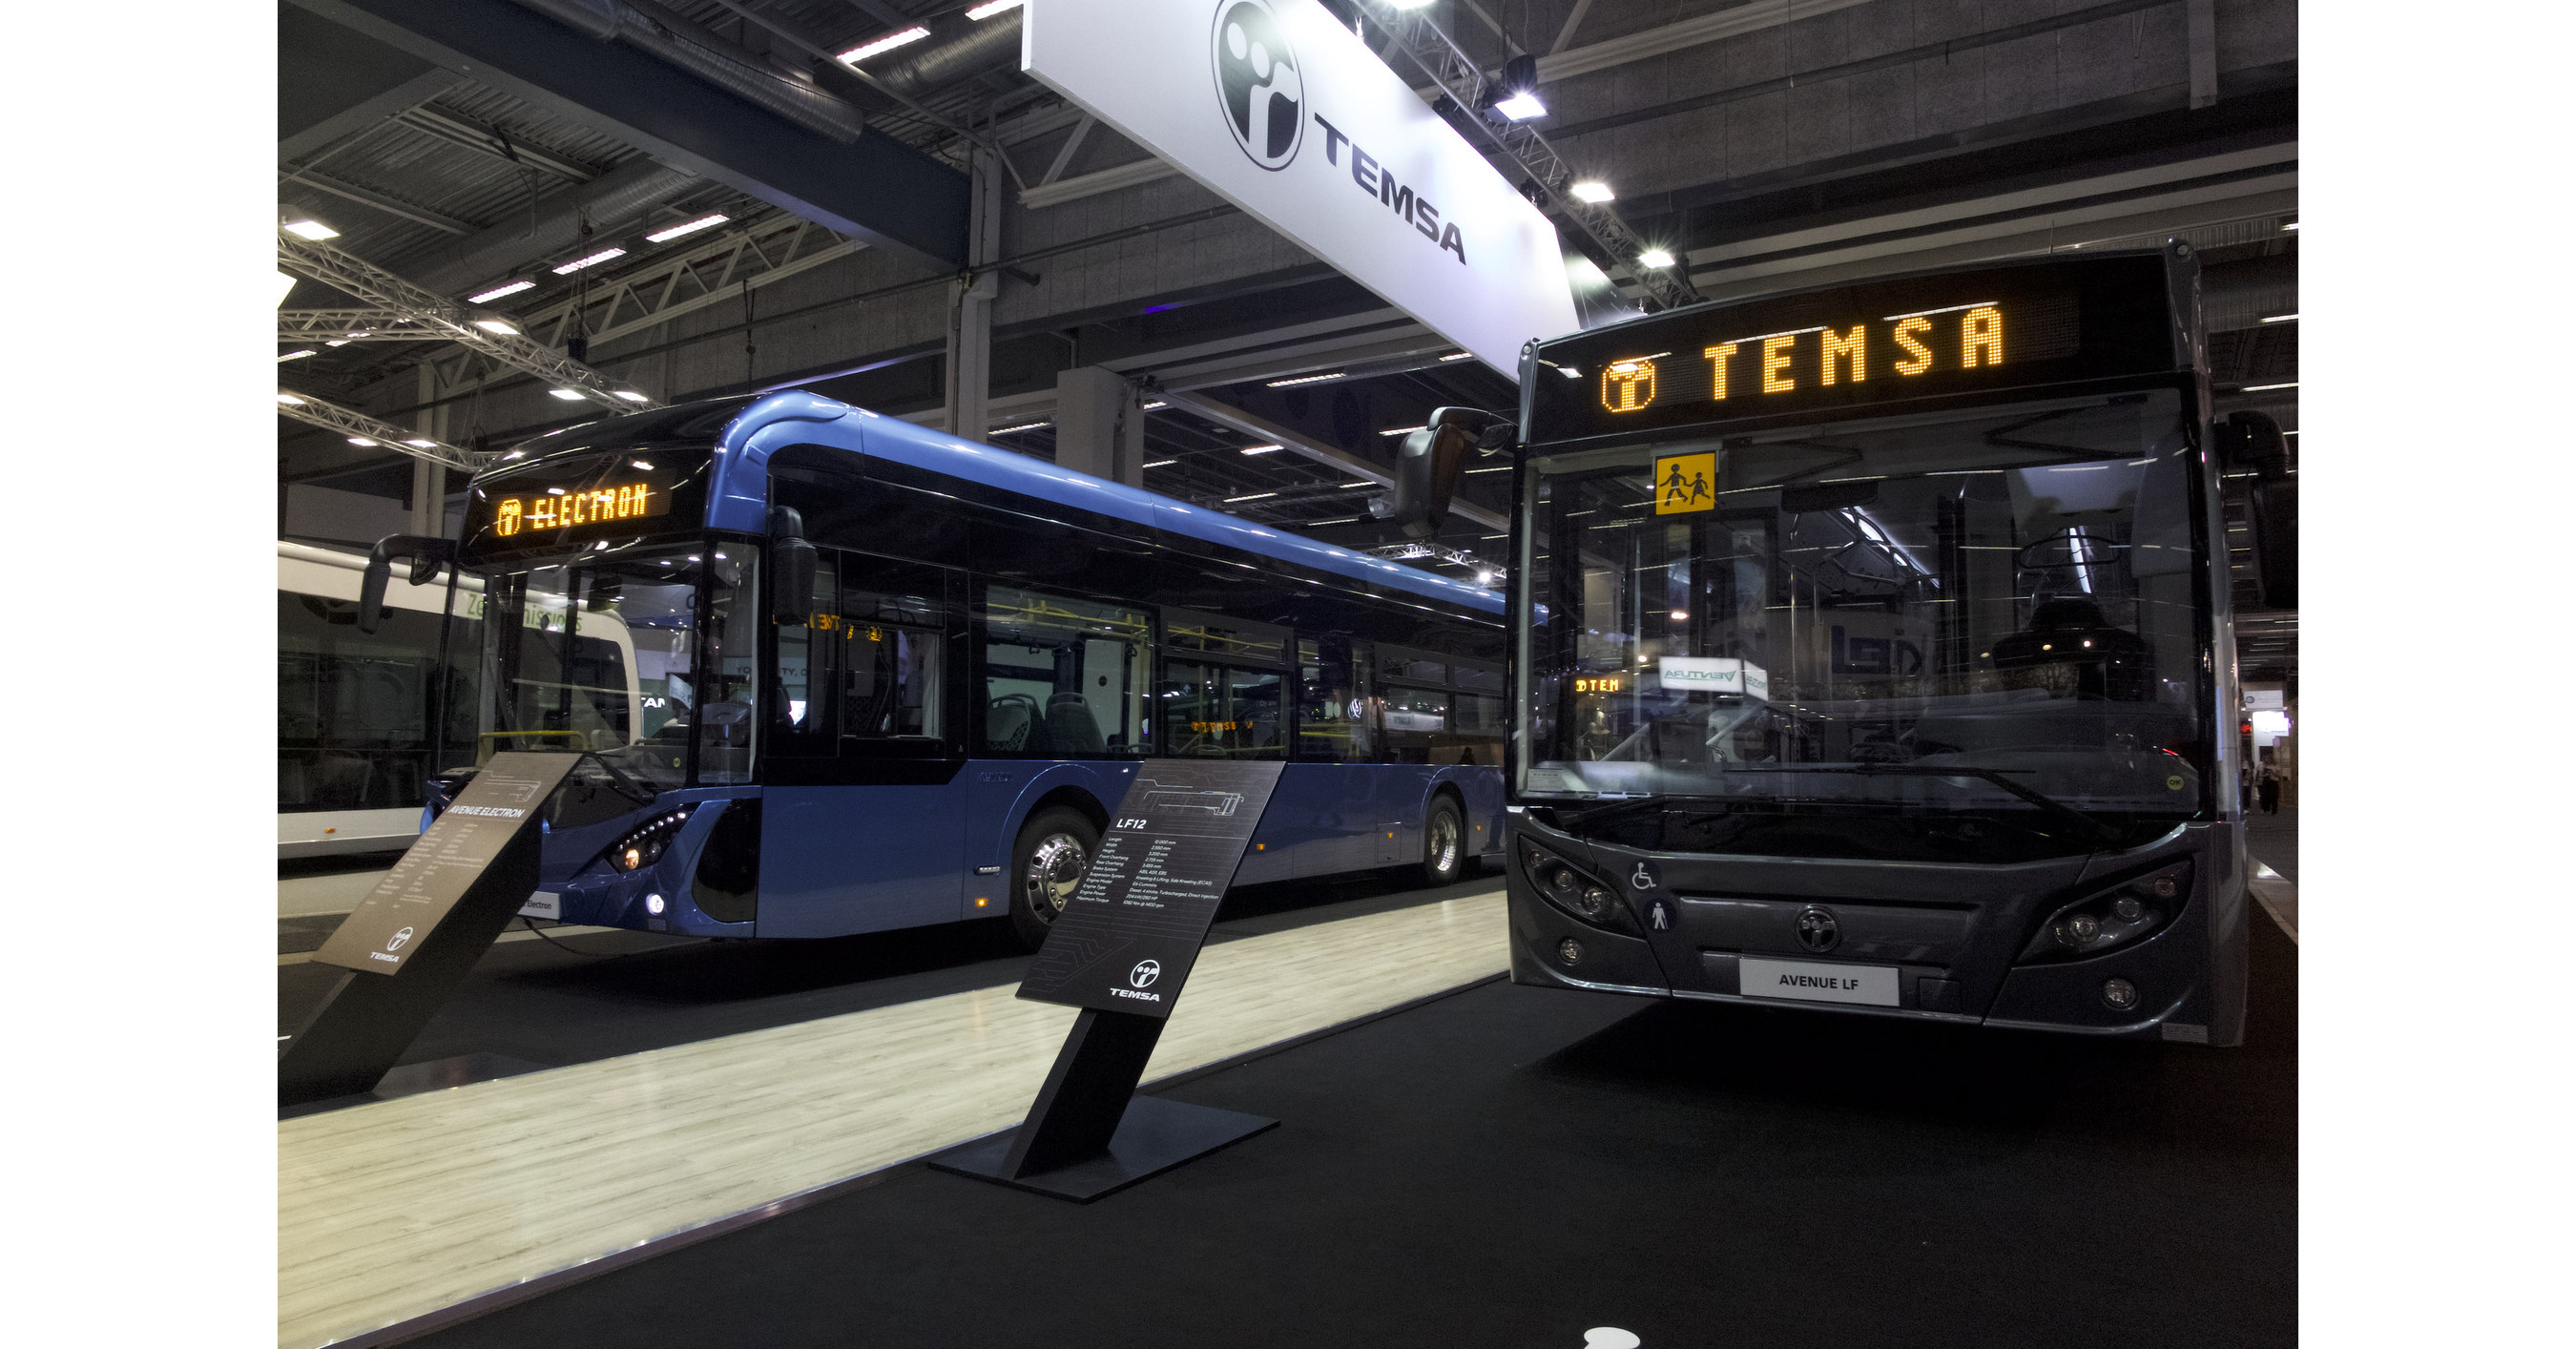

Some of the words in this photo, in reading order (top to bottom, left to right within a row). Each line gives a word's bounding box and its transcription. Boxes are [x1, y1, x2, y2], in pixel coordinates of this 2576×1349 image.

[1314, 113, 1466, 266] TEMSA
[1704, 306, 2004, 401] TEMSA
[531, 483, 649, 530] ELECTRON
[448, 805, 484, 816] AVENUE
[479, 807, 526, 818] ELECTRON
[1116, 819, 1147, 829] LF12
[527, 900, 551, 909] Electron
[370, 951, 400, 963] TEMSA
[1779, 974, 1838, 989] AVENUE
[1841, 978, 1859, 991] LF
[1110, 987, 1160, 1002] TEMSA
